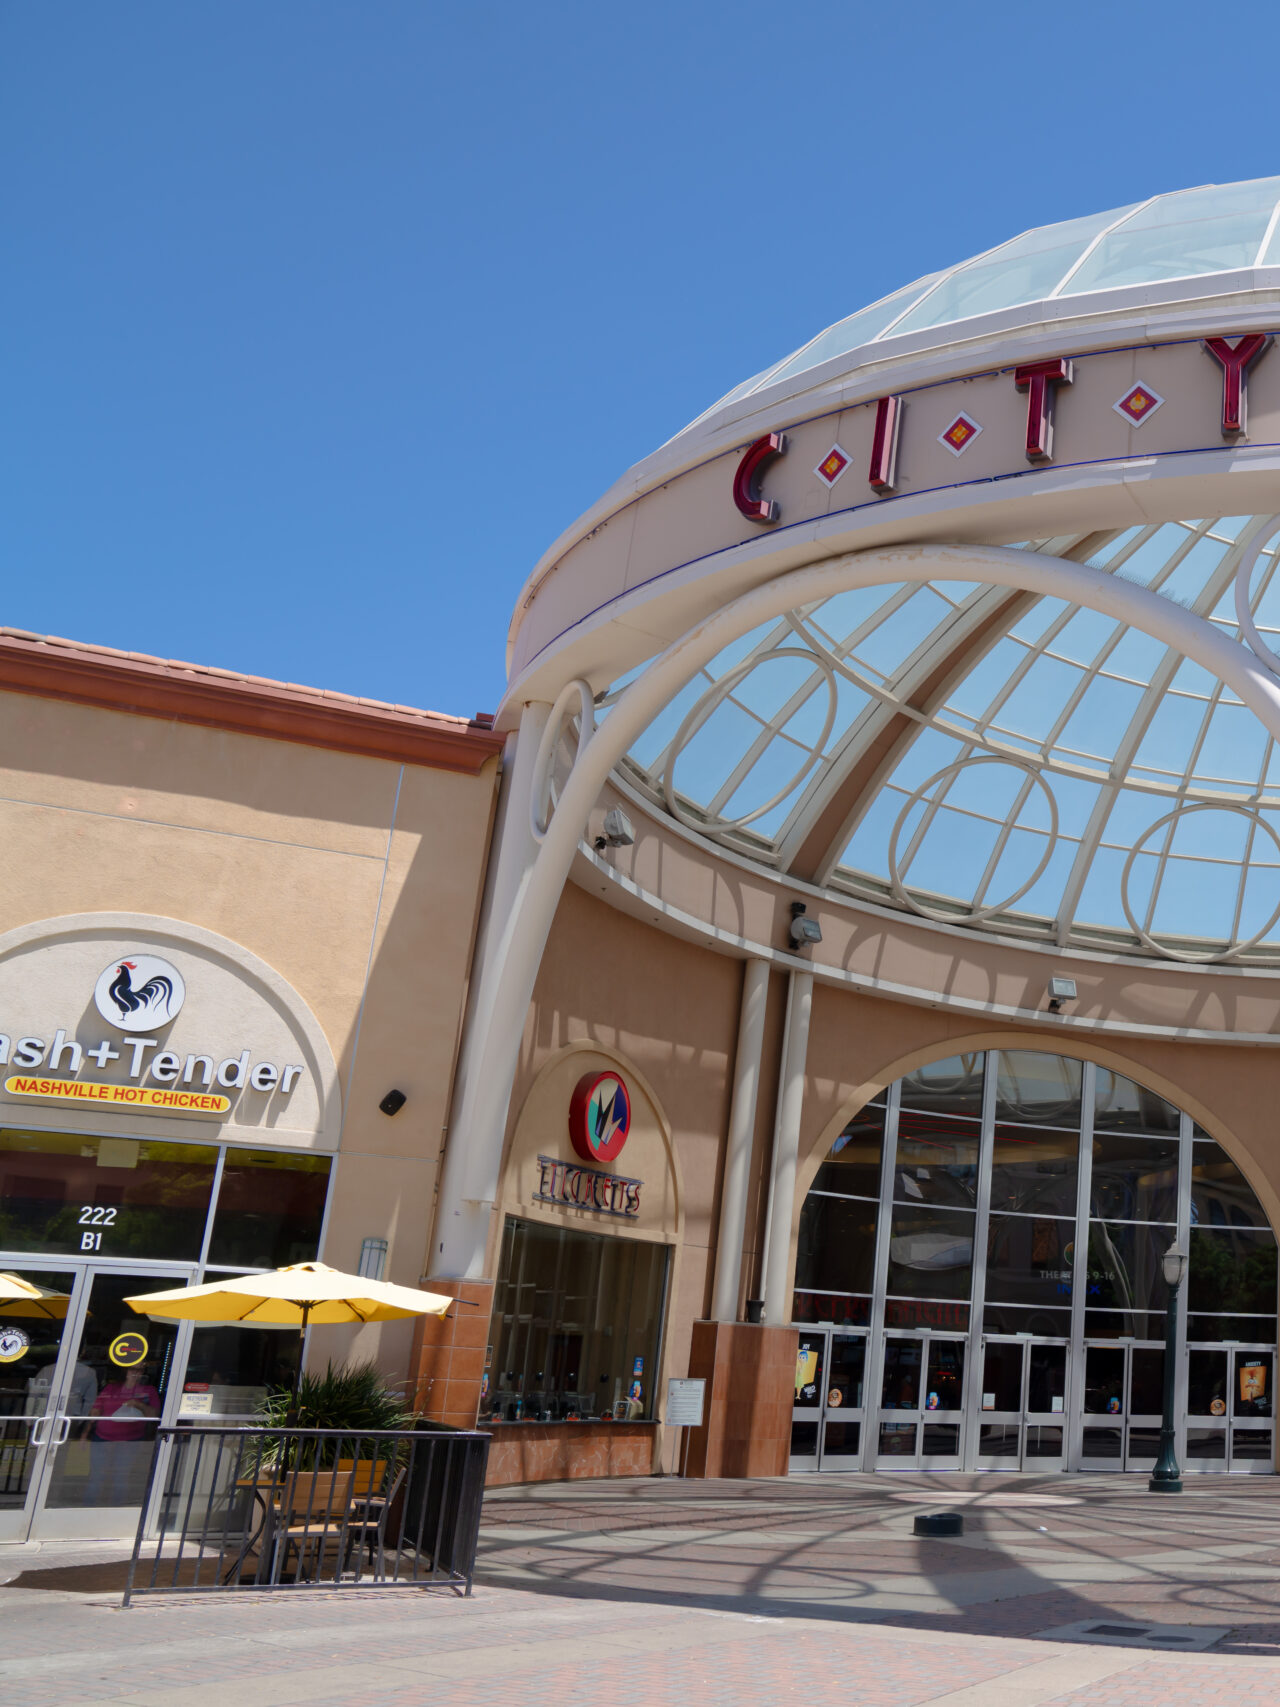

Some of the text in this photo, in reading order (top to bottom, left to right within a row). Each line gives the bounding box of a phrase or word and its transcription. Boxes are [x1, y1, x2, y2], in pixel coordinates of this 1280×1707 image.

[732, 333, 1275, 525] CITY
[14, 1079, 222, 1110] NASHVILLE HOT CHICKEN
[540, 1161, 640, 1213] TICKETS
[78, 1206, 117, 1226] 222
[80, 1231, 102, 1251] B1
